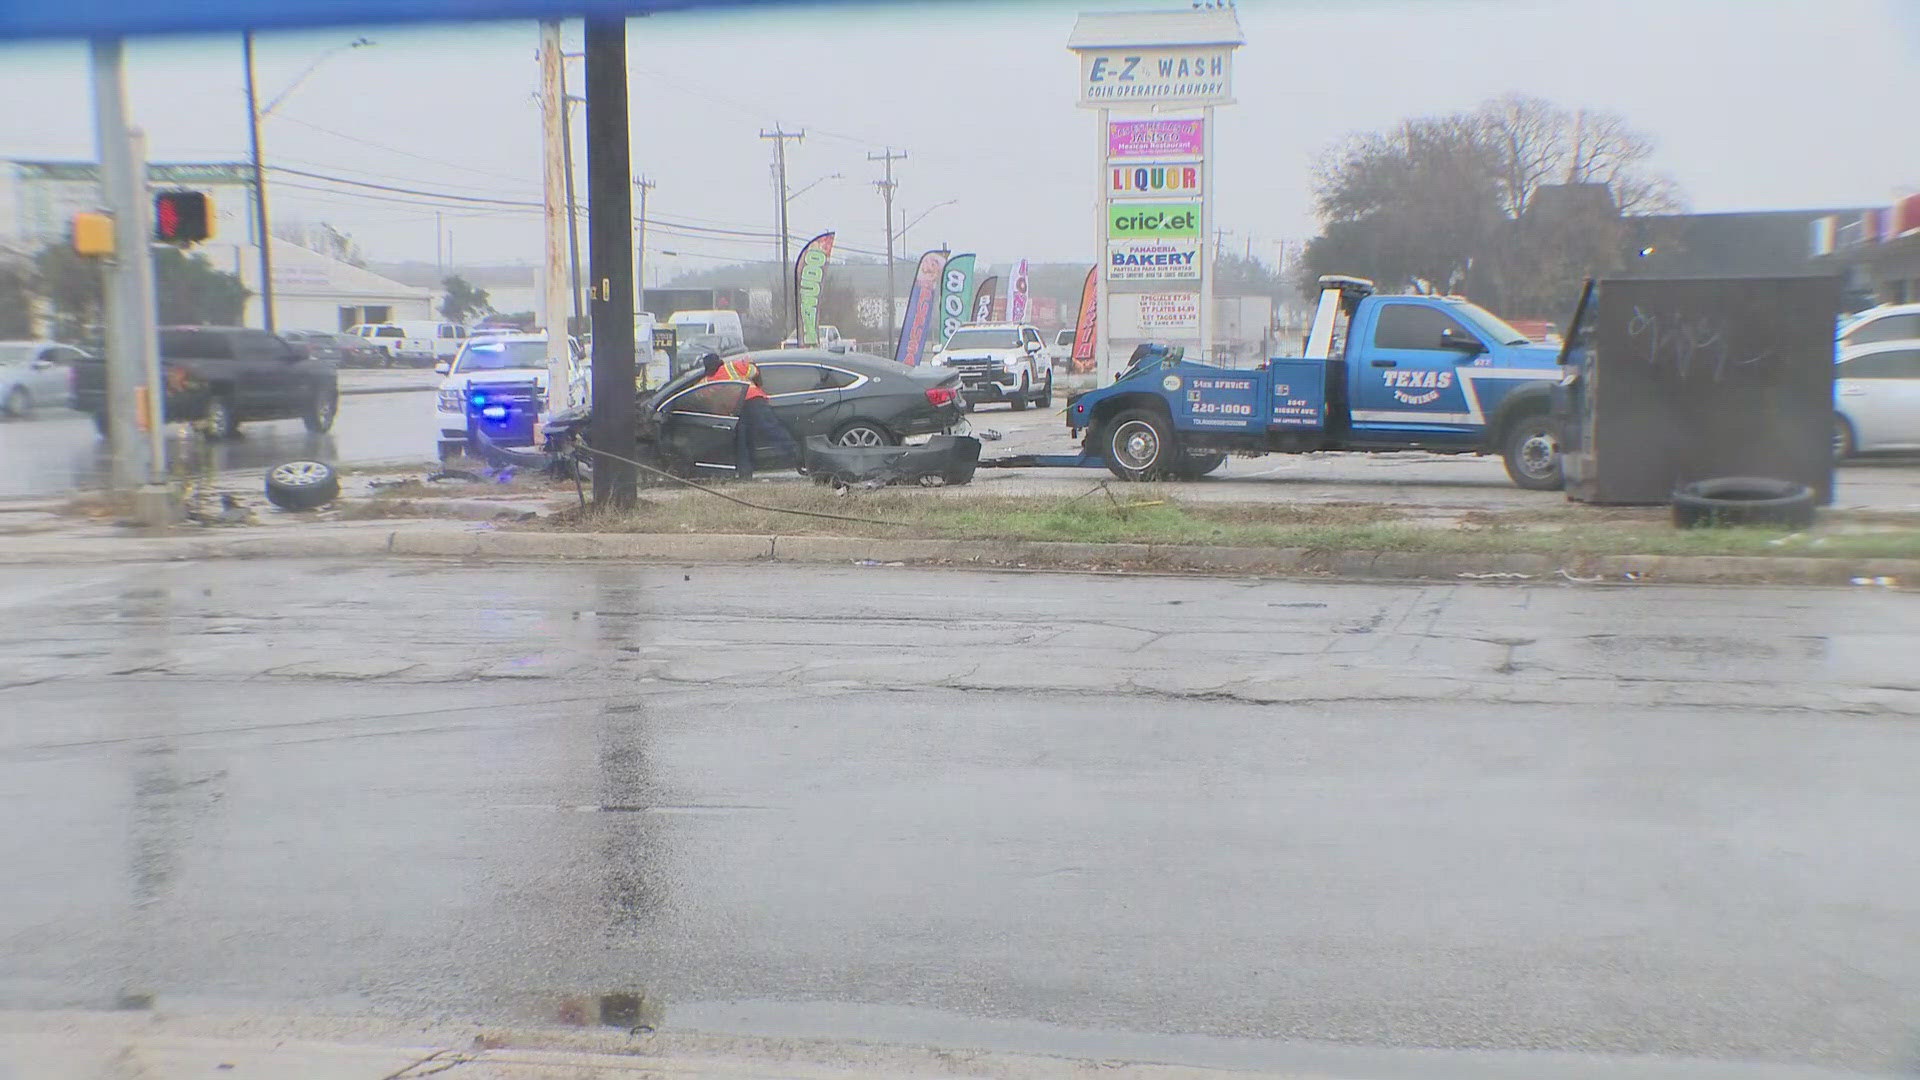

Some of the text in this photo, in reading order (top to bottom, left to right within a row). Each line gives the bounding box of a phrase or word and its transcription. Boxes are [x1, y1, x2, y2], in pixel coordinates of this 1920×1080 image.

[1089, 56, 1222, 82] E-Z WASH
[1088, 81, 1223, 97] COIN OPERATED LAUNDRY
[1150, 141, 1191, 149] Restaurant
[1113, 167, 1196, 191] LIQUOR
[1115, 211, 1195, 230] cricket
[1112, 251, 1195, 265] BAKERY
[1214, 380, 1251, 389] SERVICE
[1383, 370, 1452, 388] TEXAS
[1393, 389, 1440, 405] TOWING
[1191, 403, 1251, 415] 220-1000
